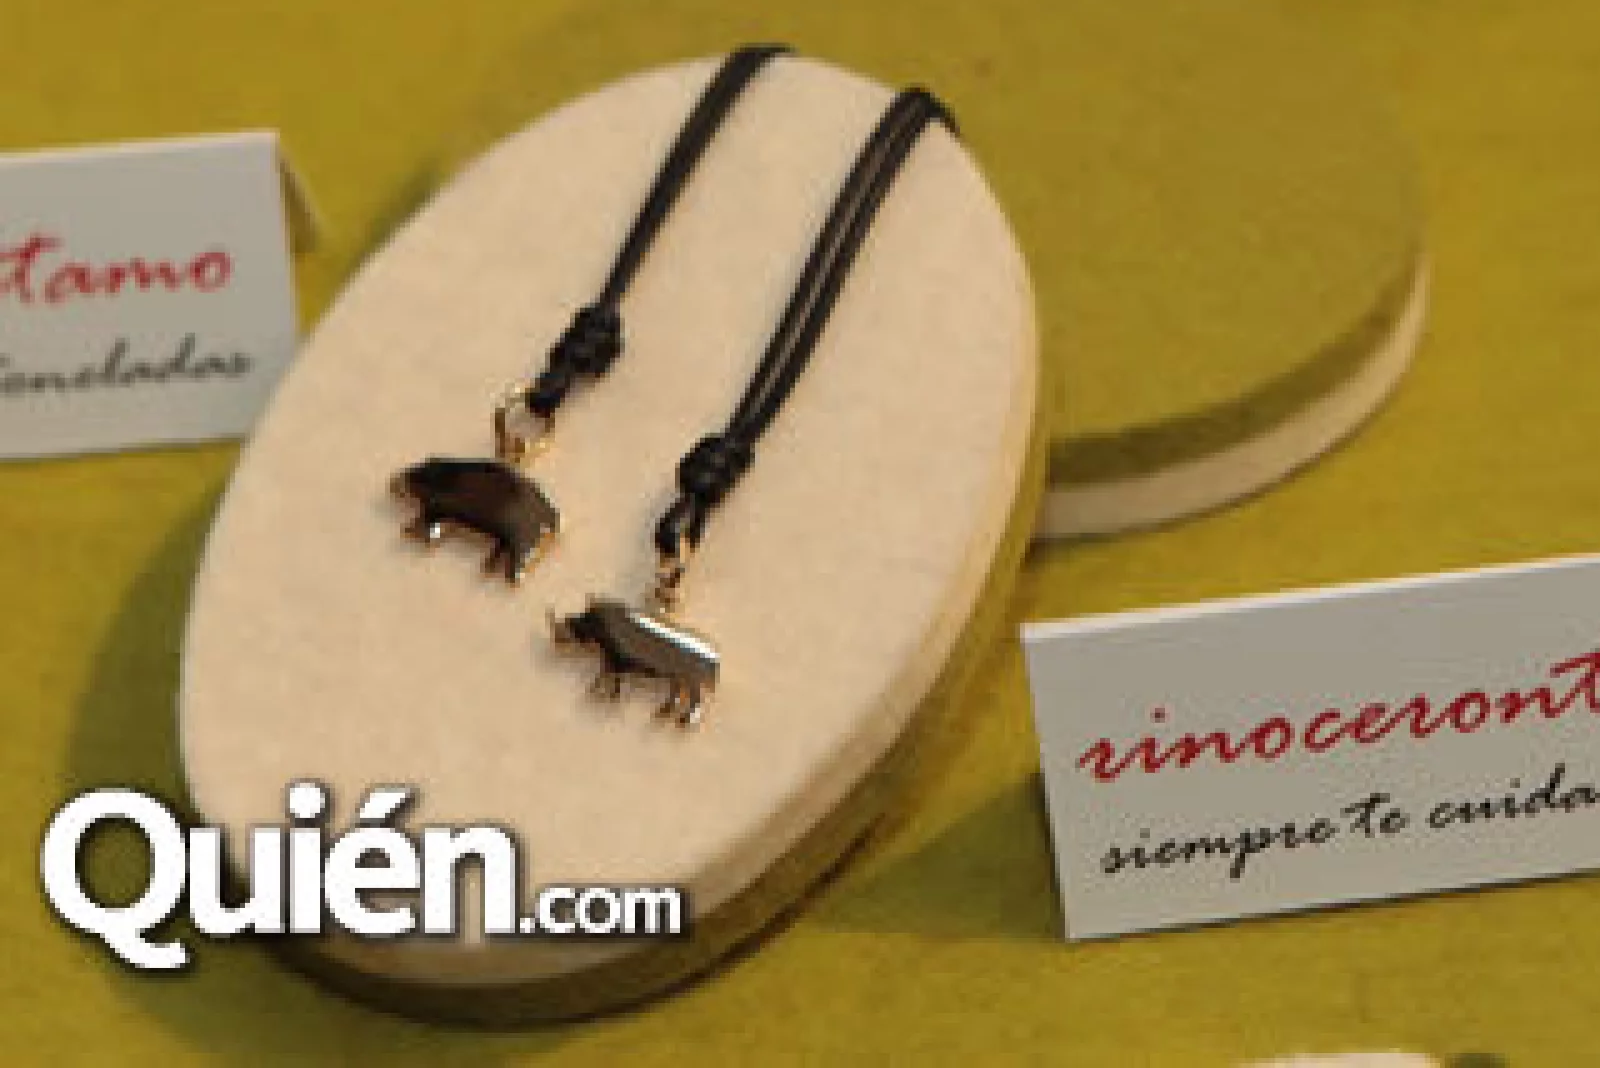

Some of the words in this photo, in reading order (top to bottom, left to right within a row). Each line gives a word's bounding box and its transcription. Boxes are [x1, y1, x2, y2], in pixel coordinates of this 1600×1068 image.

[0, 231, 235, 306] tamo
[0, 332, 255, 397] oneladas
[1101, 821, 1336, 880] siempre
[1346, 792, 1410, 838] te
